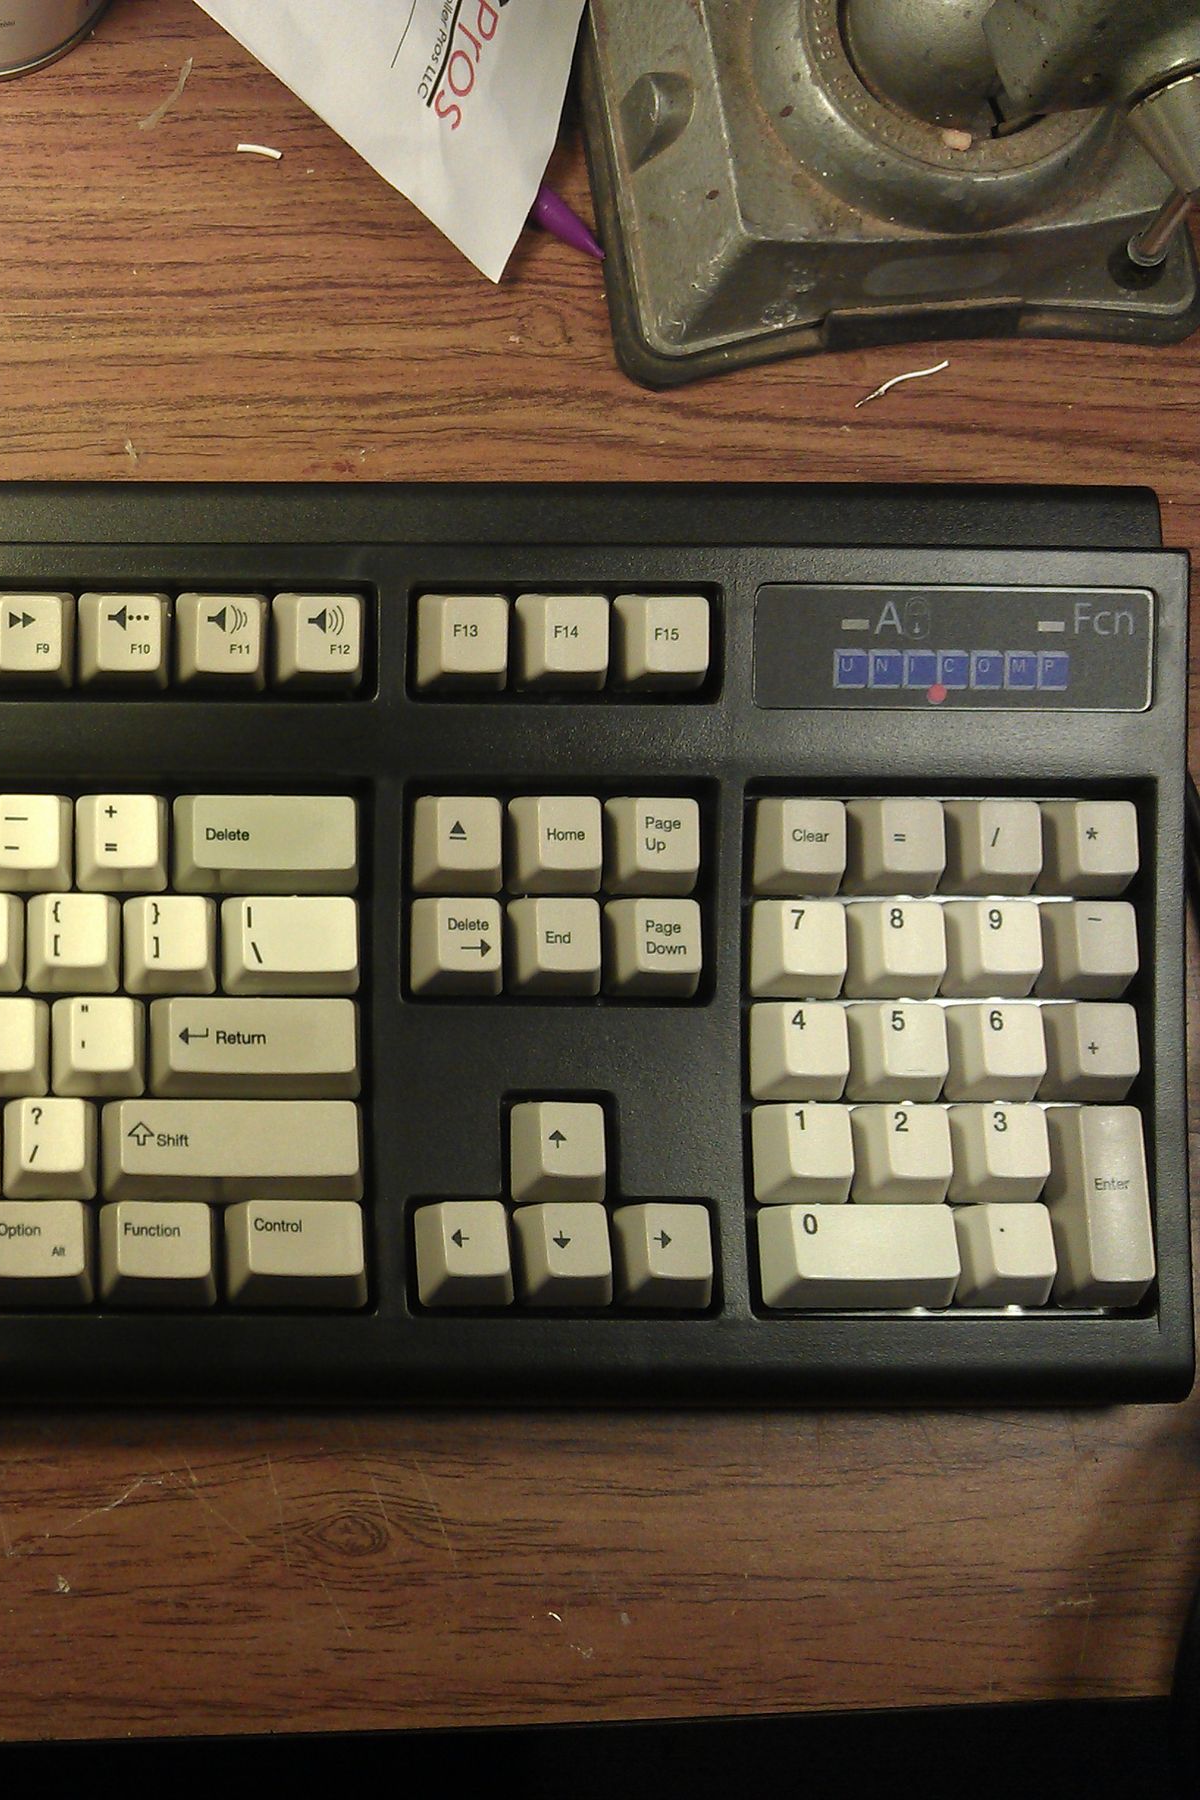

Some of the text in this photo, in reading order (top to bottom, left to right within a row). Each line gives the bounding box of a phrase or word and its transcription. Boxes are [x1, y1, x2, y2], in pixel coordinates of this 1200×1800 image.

[431, 28, 448, 64] Pros
[417, 65, 437, 100] LLC
[1073, 602, 1135, 637] Fcn
[453, 623, 479, 638] F13
[553, 625, 579, 639] F14
[654, 627, 680, 642] F15
[35, 642, 50, 654] F9
[130, 643, 151, 655] F10
[229, 643, 250, 655] F11
[329, 643, 351, 655] F12
[104, 805, 118, 819] +
[644, 815, 682, 833] Page
[205, 827, 250, 842] Delete
[546, 827, 586, 842] Home
[791, 828, 830, 843] Clear
[893, 833, 906, 843] =
[990, 826, 1001, 848] /
[104, 842, 118, 852] =
[645, 837, 667, 854] Up
[52, 900, 61, 924] {
[151, 902, 161, 926] }
[790, 908, 806, 930] 7
[889, 907, 905, 929] 8
[988, 908, 1003, 931] 9
[447, 917, 490, 932] Delete
[645, 919, 682, 937] Page
[544, 930, 572, 945] End
[250, 941, 263, 964] \
[645, 940, 688, 956] Down
[791, 1009, 807, 1031] 4
[891, 1010, 906, 1032] 5
[989, 1009, 1004, 1032] 6
[215, 1030, 267, 1045] Return
[1087, 1041, 1100, 1055] +
[31, 1106, 43, 1126] ?
[794, 1109, 806, 1131] 1
[893, 1110, 909, 1133] 2
[993, 1111, 1008, 1133] 3
[156, 1133, 190, 1148] Shift
[28, 1144, 39, 1164] /
[1093, 1177, 1131, 1191] Enter
[123, 1221, 181, 1238] Function
[253, 1217, 303, 1233] Control
[802, 1213, 819, 1235] 0
